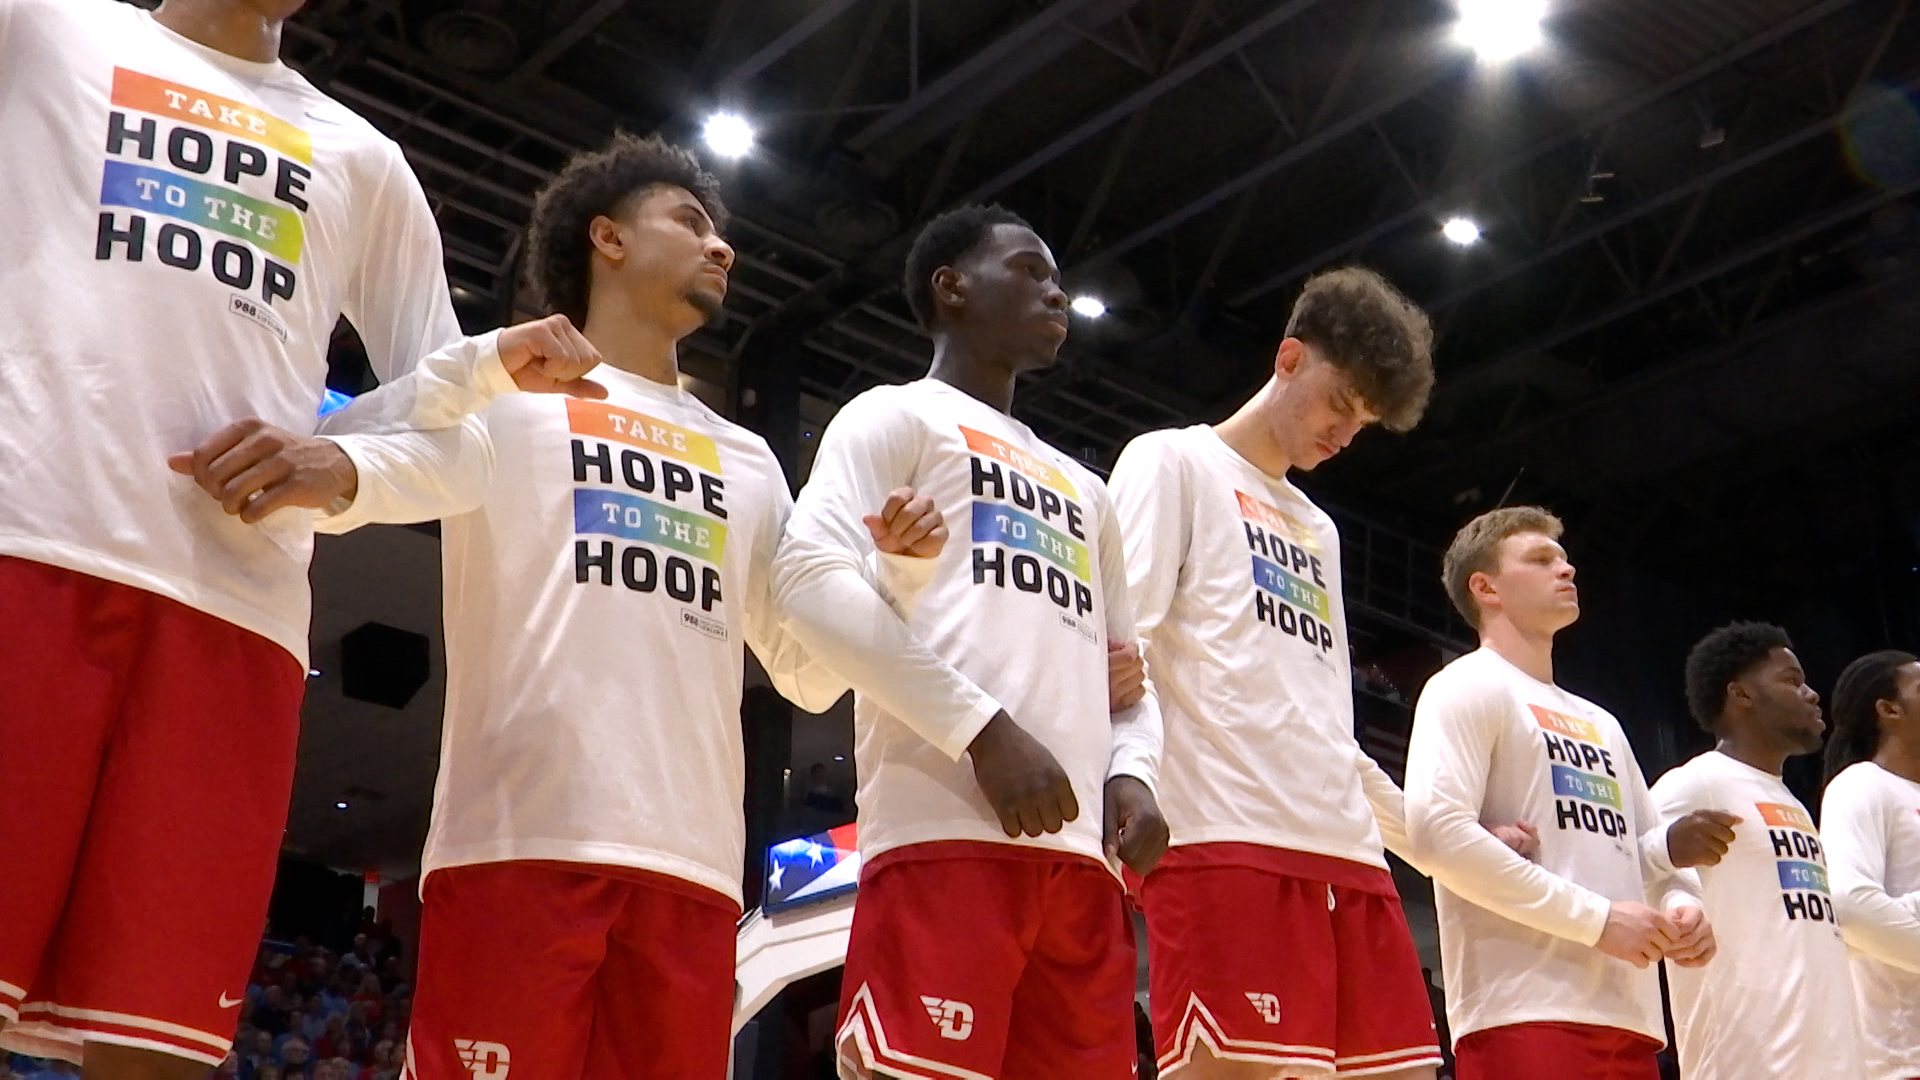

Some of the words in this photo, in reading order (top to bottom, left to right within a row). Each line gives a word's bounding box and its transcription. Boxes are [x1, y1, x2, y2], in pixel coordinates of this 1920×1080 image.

[165, 89, 267, 136] TAKE
[106, 111, 312, 213] HOPE
[136, 177, 186, 208] TO
[204, 196, 278, 240] THE
[95, 212, 296, 306] HOOP
[235, 299, 257, 316] 988
[608, 414, 687, 452] TAKE
[571, 439, 728, 519] HOPE
[970, 457, 1086, 541] HOPE
[602, 503, 642, 528] TO
[655, 514, 710, 549] THE
[996, 515, 1027, 540] TO
[1037, 529, 1077, 566] THE
[575, 540, 723, 612] HOOP
[1243, 520, 1326, 589] HOPE
[973, 548, 1092, 617] HOOP
[1265, 568, 1285, 590] TO
[1290, 582, 1320, 610] THE
[1256, 589, 1333, 653] HOOP
[1542, 731, 1617, 778] HOPE
[1565, 774, 1583, 792] TO
[1556, 799, 1628, 841] HOOP
[1791, 868, 1810, 882] TO
[1782, 891, 1840, 926] HOO
